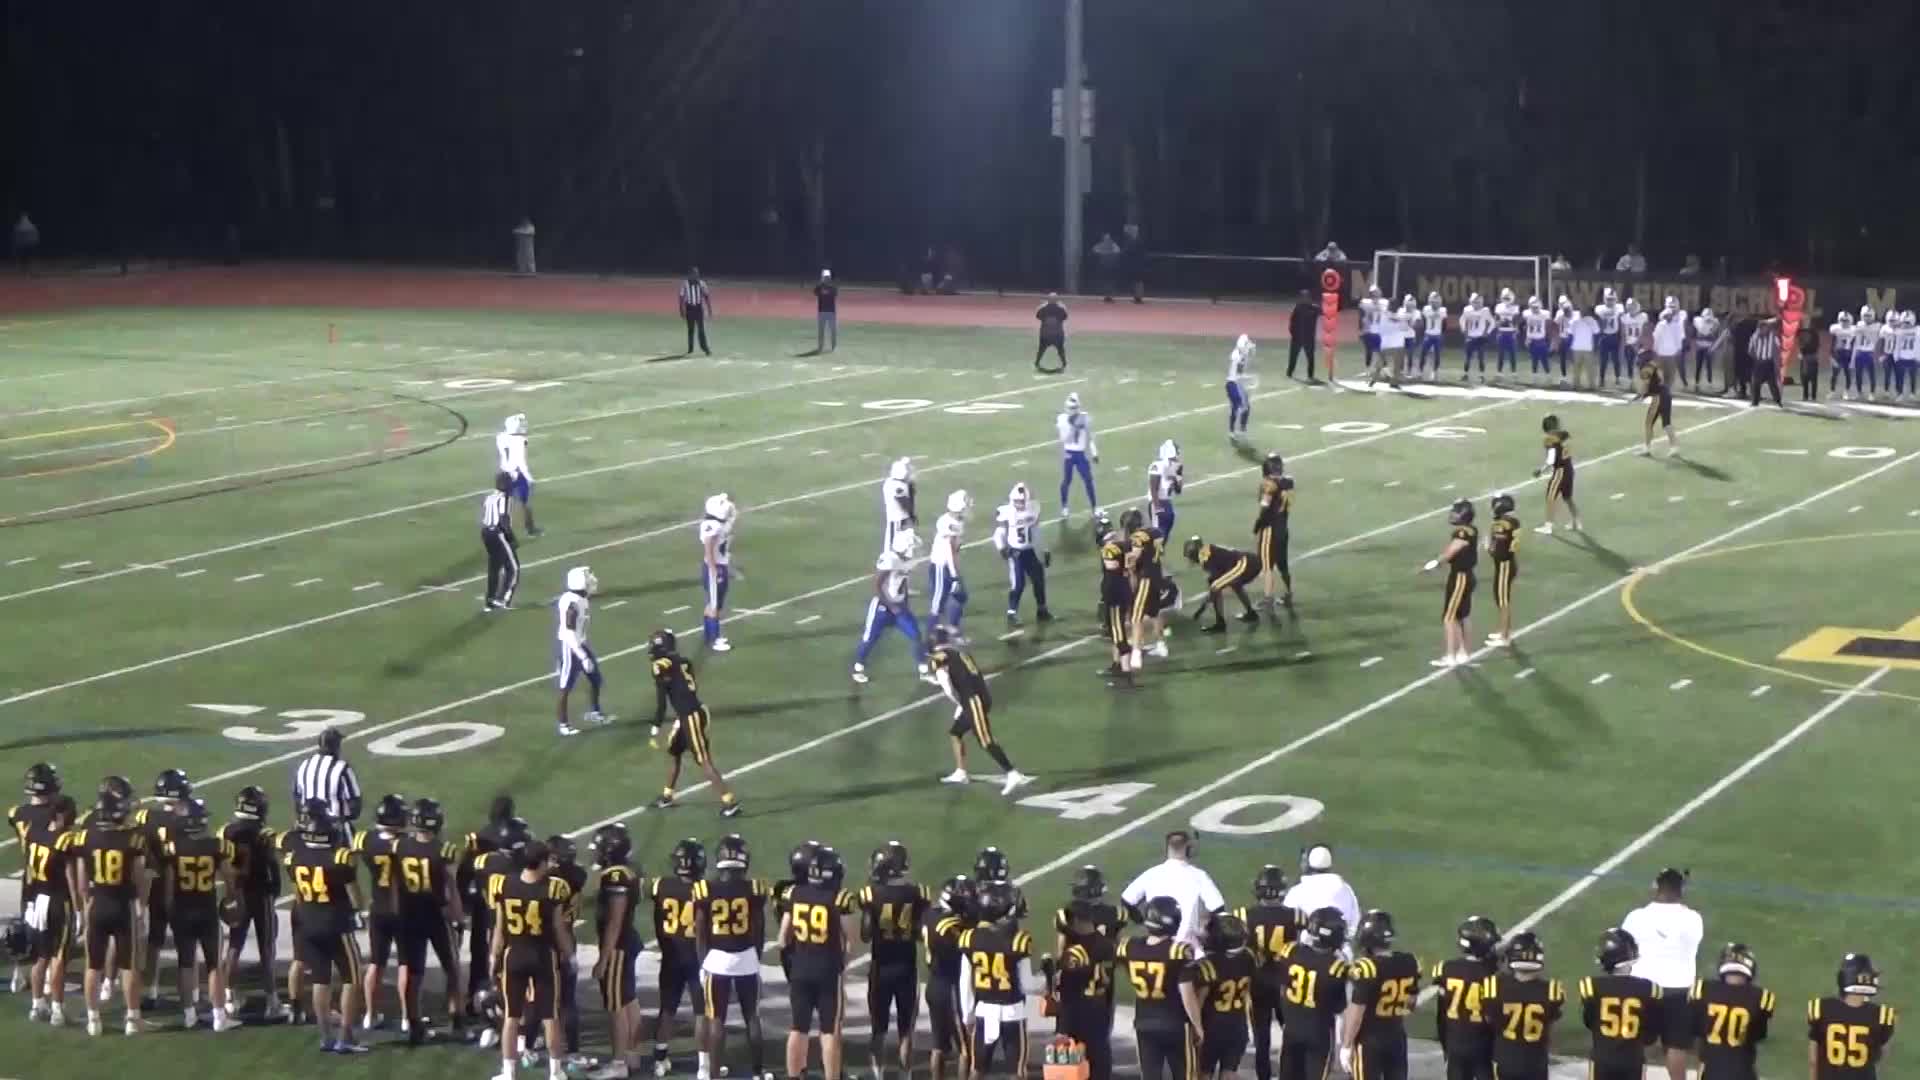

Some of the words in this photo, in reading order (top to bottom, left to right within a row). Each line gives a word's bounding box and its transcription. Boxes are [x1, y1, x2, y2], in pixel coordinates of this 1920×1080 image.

[1710, 285, 1823, 318] SCHOL
[222, 708, 505, 756] 30
[1015, 781, 1325, 834] 40
[92, 848, 123, 885] 18
[178, 855, 215, 892] 52
[295, 865, 331, 903] 64
[504, 898, 543, 936] 54
[663, 897, 697, 938] 34
[711, 897, 750, 936] 23
[792, 902, 829, 944] 59
[972, 951, 1012, 990] 24
[1128, 960, 1167, 998] 57
[1286, 963, 1317, 1009] 31
[1502, 1002, 1544, 1042] 76
[1599, 997, 1641, 1039] 56
[1706, 1002, 1750, 1047] 70
[1826, 1022, 1870, 1067] 65
